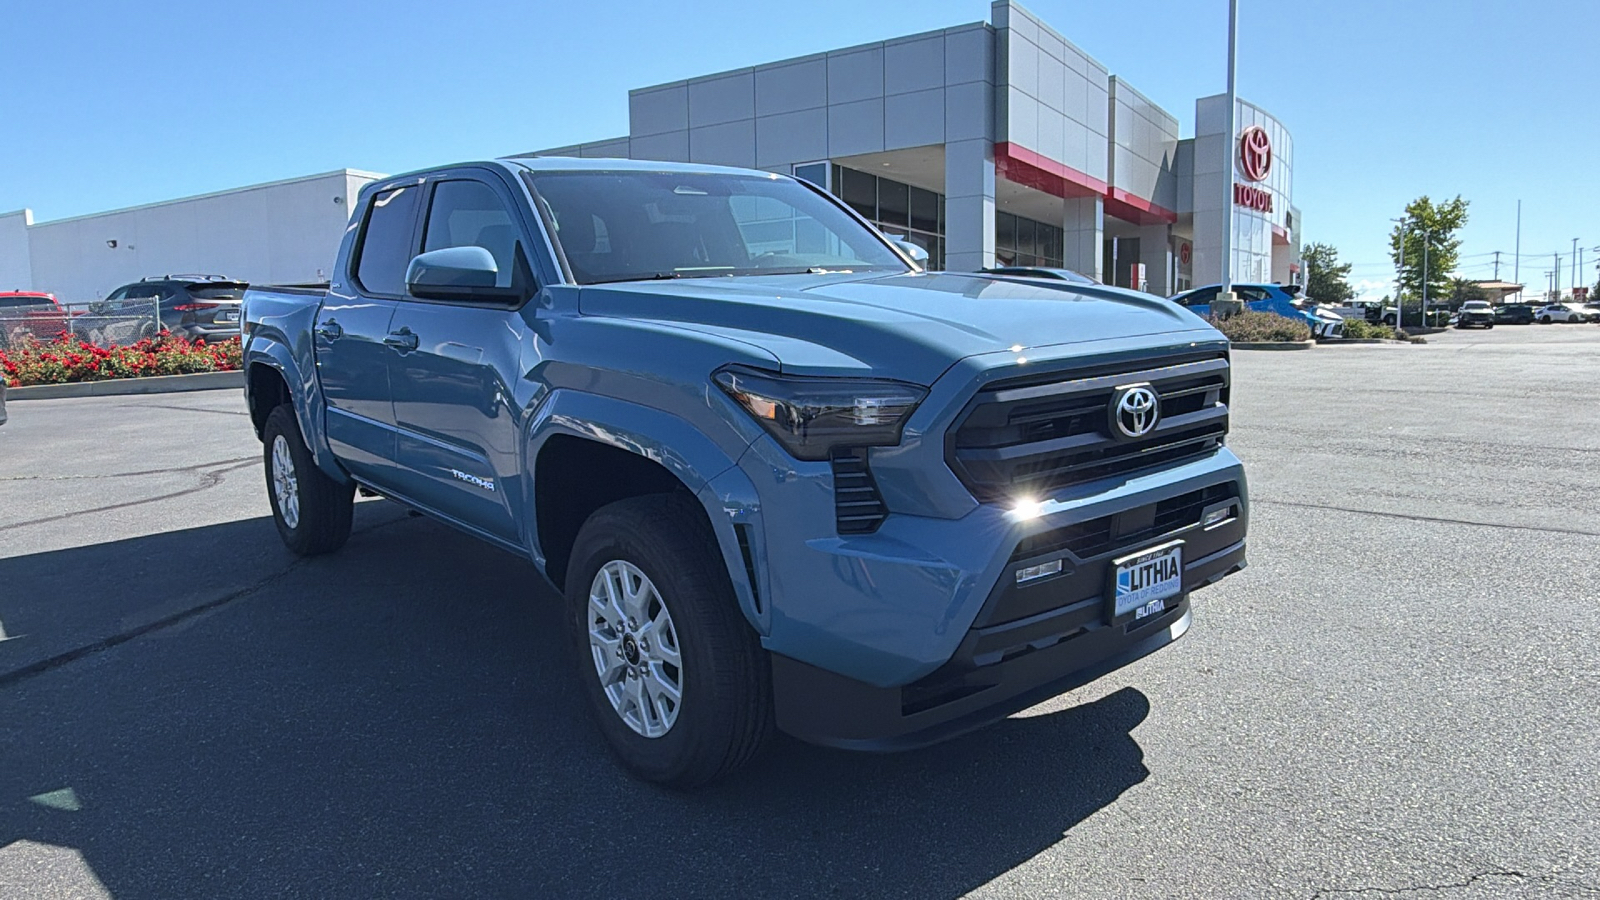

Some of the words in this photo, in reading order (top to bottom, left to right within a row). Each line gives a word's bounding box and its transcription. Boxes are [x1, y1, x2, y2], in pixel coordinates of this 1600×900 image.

[1234, 183, 1273, 213] TOYOTA
[452, 469, 495, 491] TACOMA
[1130, 556, 1179, 592] LITHIA
[1140, 588, 1150, 599] OF
[1150, 579, 1179, 595] REDDING
[1142, 600, 1165, 617] LITHIA
